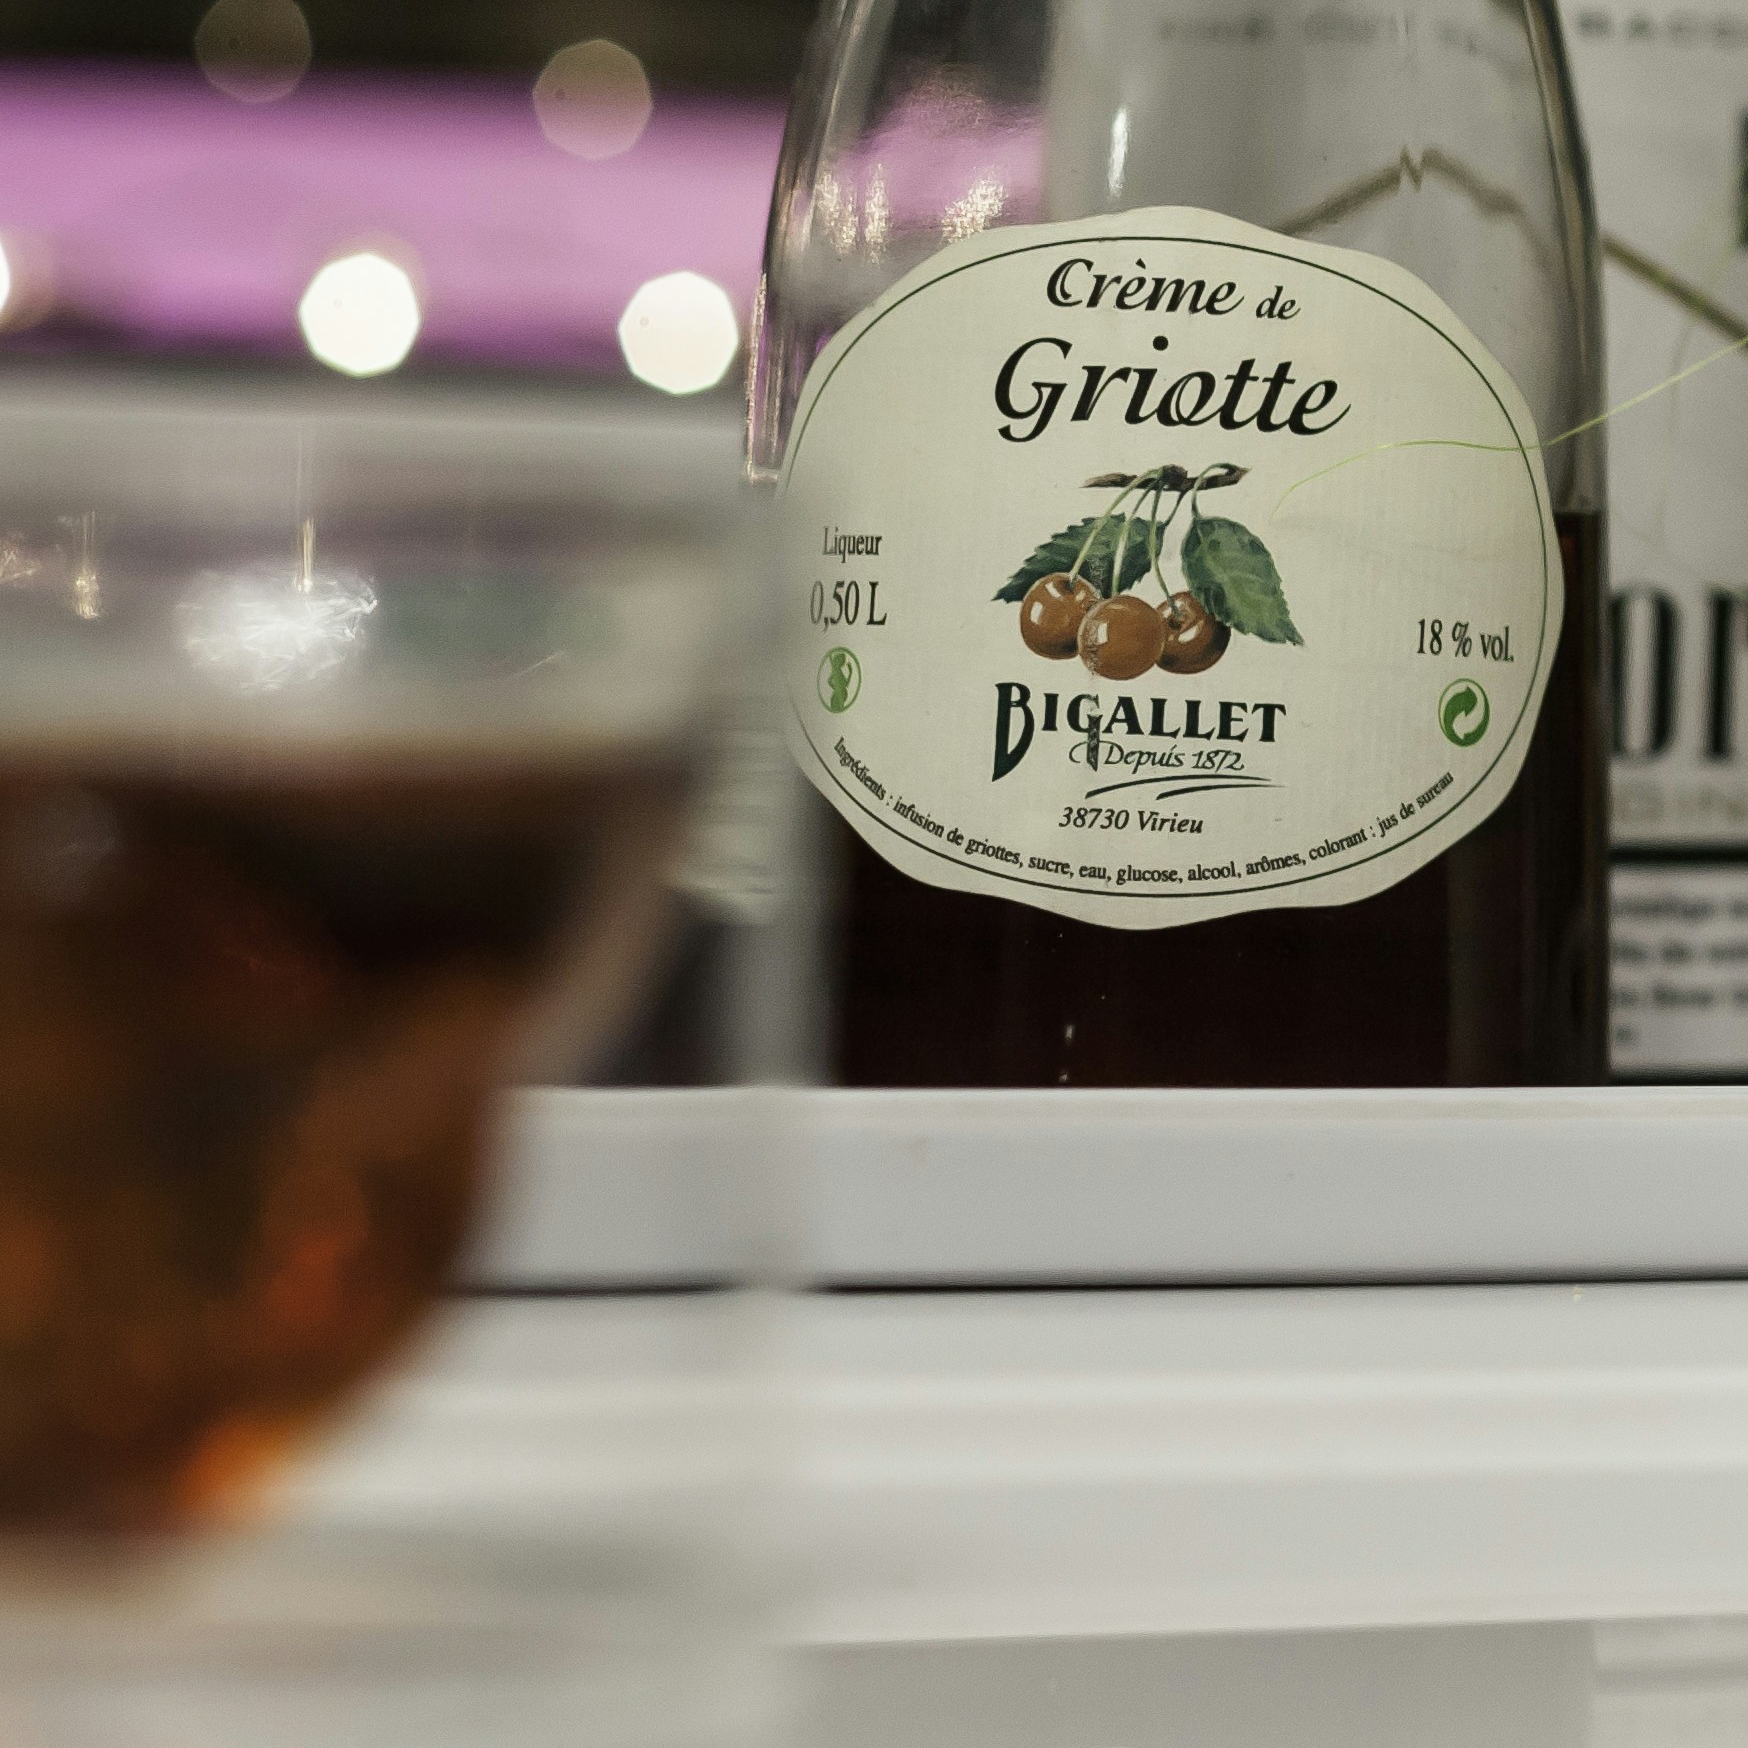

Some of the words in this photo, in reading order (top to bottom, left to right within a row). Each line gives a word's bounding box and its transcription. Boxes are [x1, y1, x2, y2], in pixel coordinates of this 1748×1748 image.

[1047, 258, 1245, 315] Crème
[1255, 285, 1301, 320] de
[994, 335, 1352, 443] Griotte
[823, 526, 882, 563] Liqueur
[810, 580, 860, 634] 0,50
[866, 580, 887, 626] L
[1416, 618, 1443, 656] 18
[1451, 620, 1472, 658] %
[1480, 625, 1514, 662] vol.
[992, 682, 1287, 782] BIGALLET
[1100, 741, 1186, 775] Depuis
[1191, 748, 1245, 773] 1872
[834, 736, 887, 801] Ingrédients
[893, 795, 945, 838] infusion
[946, 827, 965, 847] de
[964, 838, 1024, 869] griottes,
[1028, 855, 1075, 879] sucre,
[1078, 864, 1112, 882] eau,
[1116, 864, 1184, 886] glucose,
[1187, 860, 1242, 882] alcool,
[1245, 851, 1307, 875] arômes,
[1308, 827, 1368, 860] colorant
[1376, 815, 1399, 838] jus
[1399, 802, 1416, 820] de
[1415, 771, 1455, 810] sureau
[1058, 806, 1130, 830] 38730
[1136, 810, 1204, 834] Virieu
